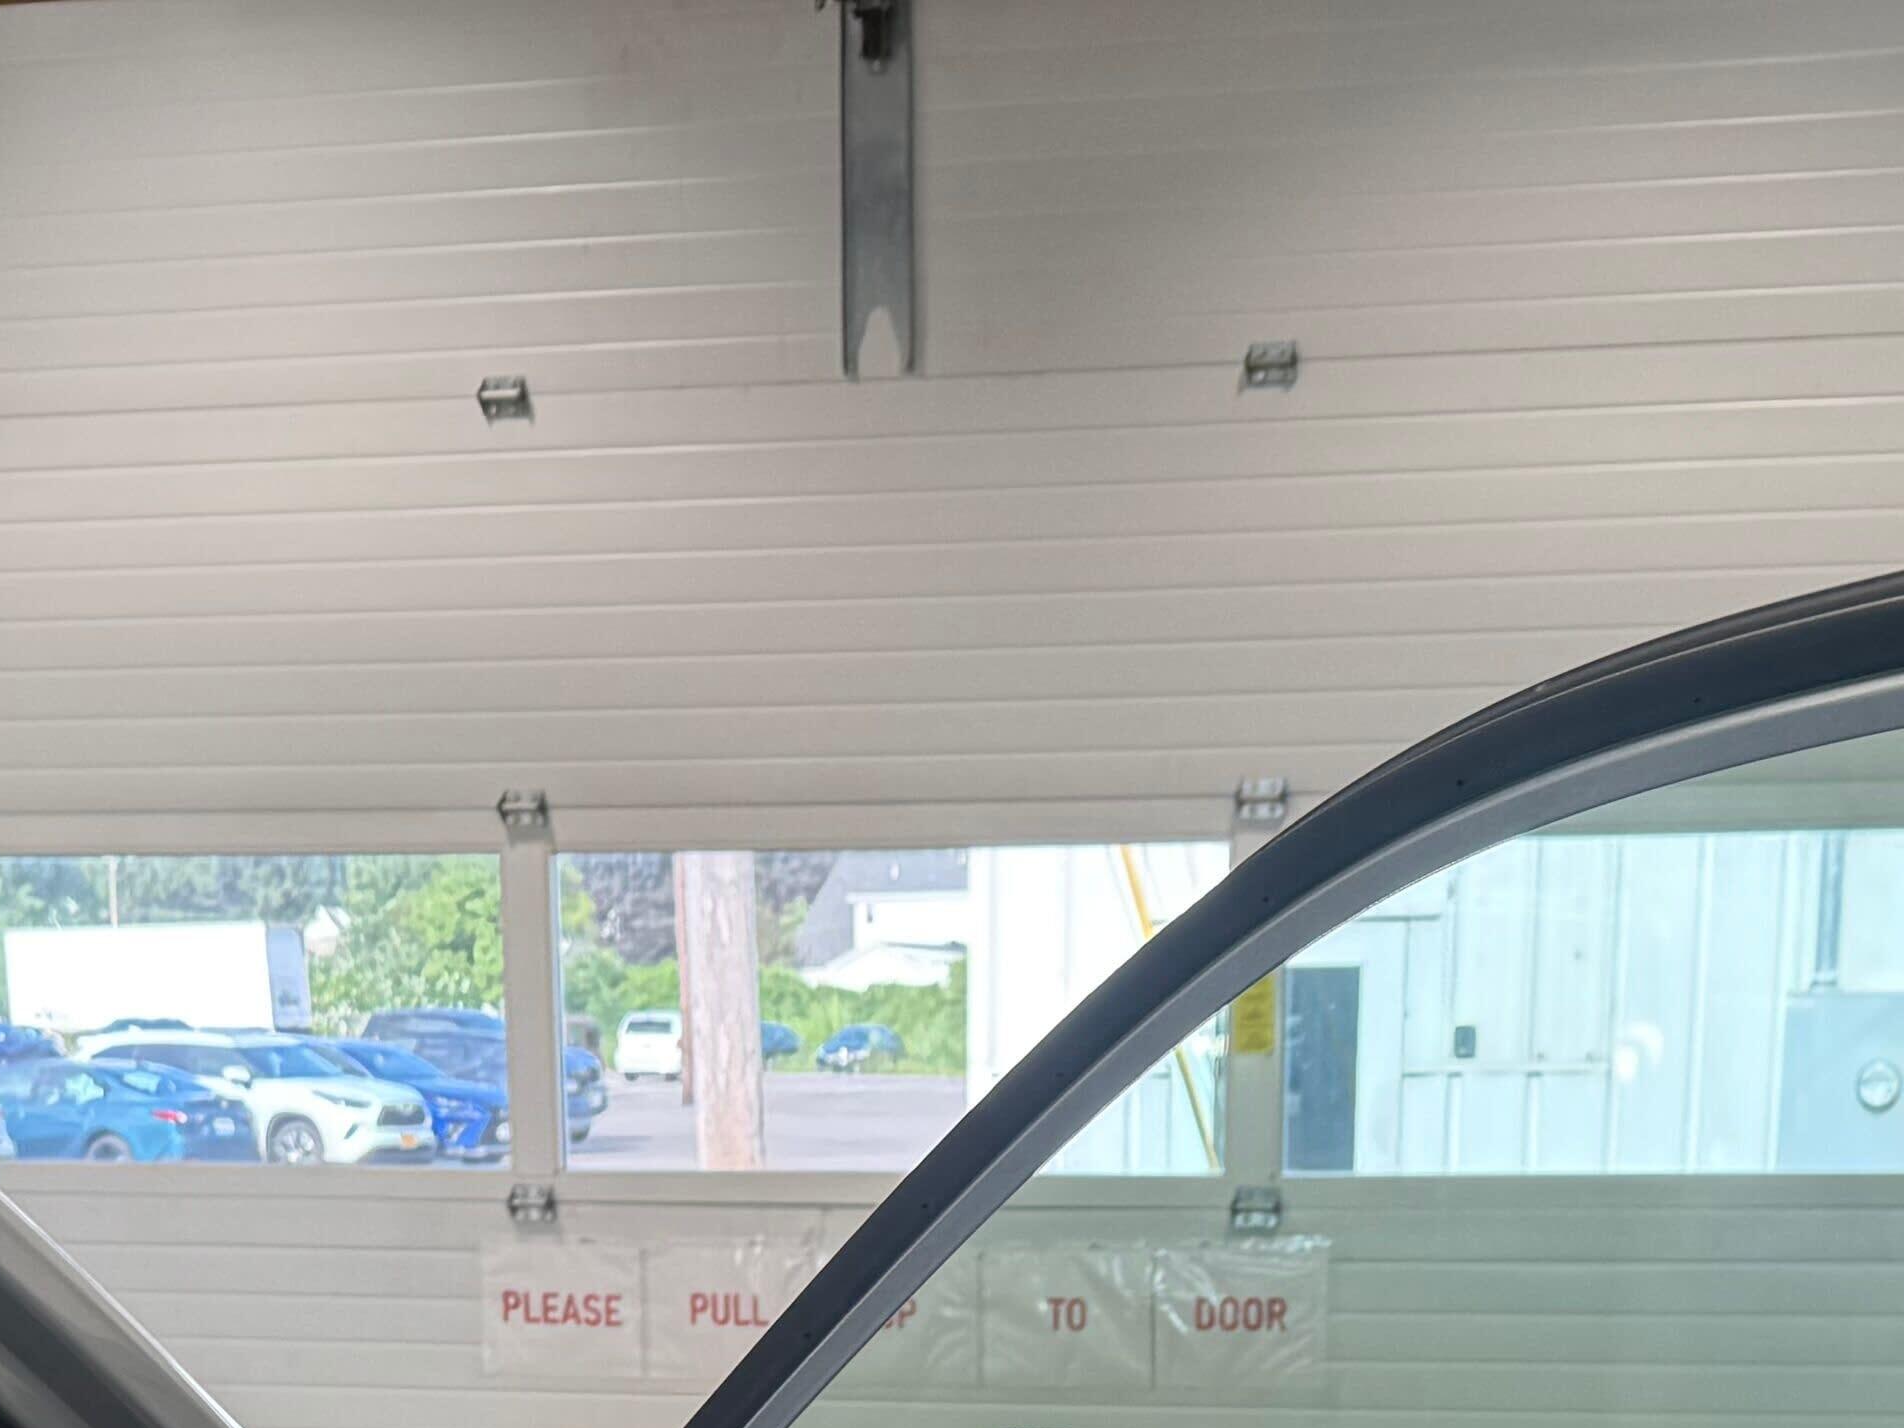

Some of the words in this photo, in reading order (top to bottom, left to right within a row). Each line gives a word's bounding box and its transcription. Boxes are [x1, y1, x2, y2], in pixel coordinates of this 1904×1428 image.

[501, 1290, 623, 1327] PLEASE
[688, 1292, 769, 1327] PULL
[1045, 1296, 1088, 1331] TO
[1194, 1296, 1289, 1332] DOOR
